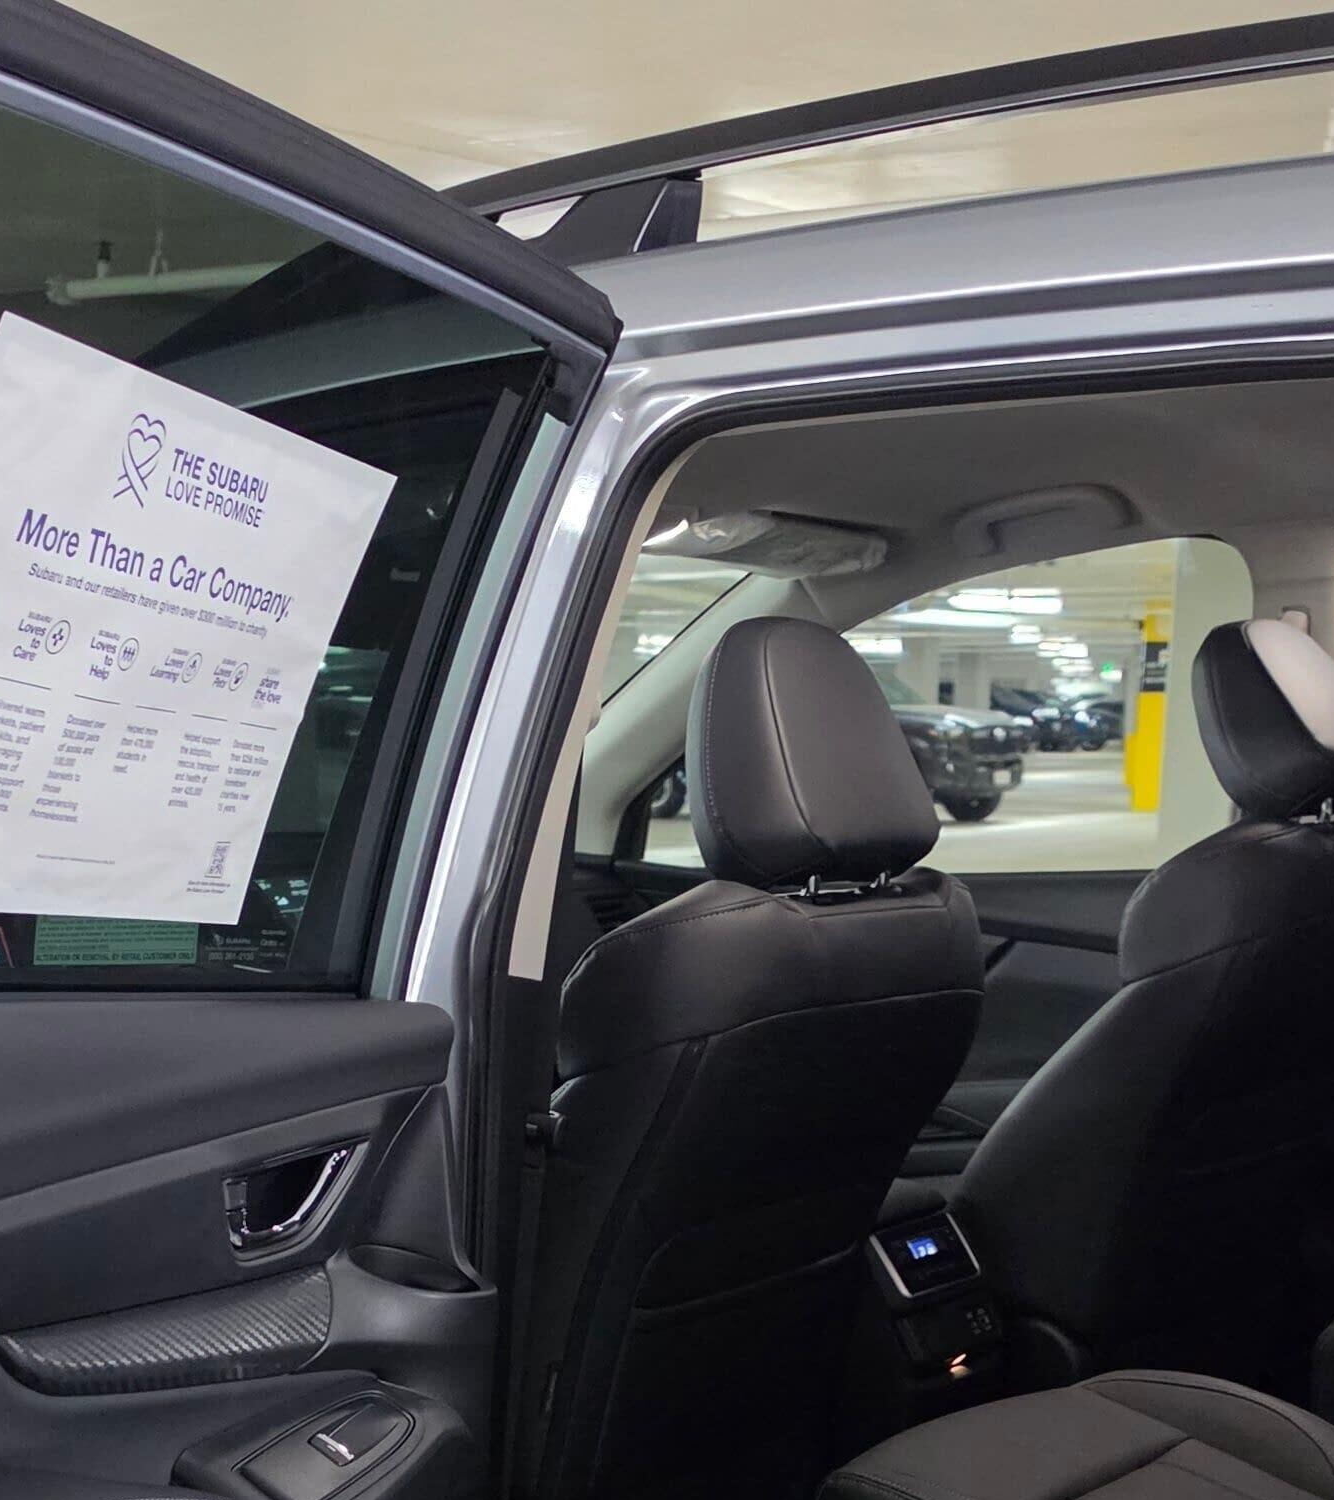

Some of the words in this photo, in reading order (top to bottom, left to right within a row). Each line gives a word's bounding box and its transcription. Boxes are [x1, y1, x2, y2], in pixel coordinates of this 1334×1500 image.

[173, 448, 205, 480] THE
[207, 462, 268, 503] SUBARU
[165, 476, 202, 507] LOVE
[204, 491, 263, 528] PROMISE
[16, 508, 79, 557] More
[89, 528, 144, 577] Than
[150, 558, 163, 582] a
[170, 555, 206, 593] Car
[28, 563, 63, 584] Subaru
[65, 576, 83, 589] and
[85, 581, 101, 593] our
[101, 586, 137, 603] retailers
[138, 594, 159, 610] have
[18, 619, 47, 636] Loves
[30, 638, 40, 649] to
[90, 637, 117, 654] Loves
[13, 645, 37, 661] Care
[104, 655, 113, 666] to
[89, 664, 109, 681] Help
